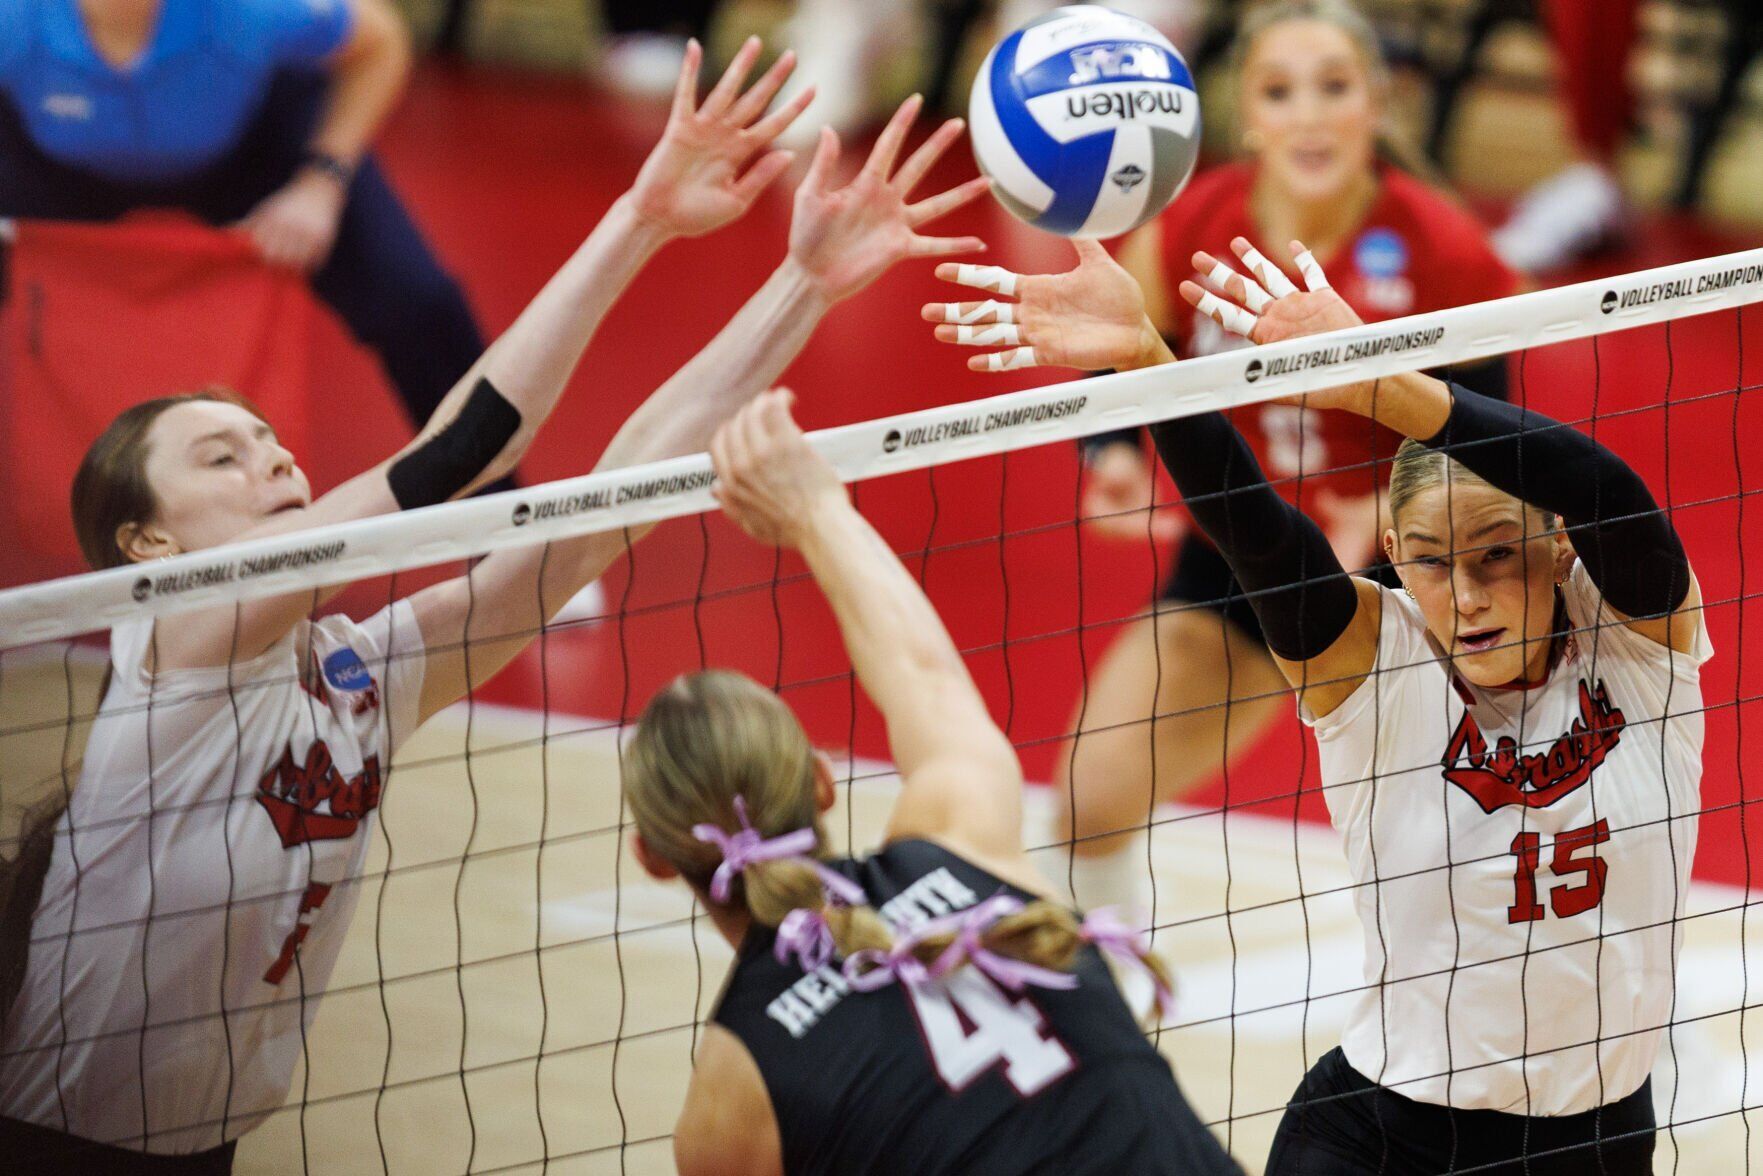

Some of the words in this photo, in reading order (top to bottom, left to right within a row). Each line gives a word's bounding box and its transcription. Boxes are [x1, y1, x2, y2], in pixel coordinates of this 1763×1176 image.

[1067, 90, 1183, 119] molten
[1620, 277, 1693, 308] VOLLEYBALL
[1264, 348, 1341, 377] VOLLEYBALL
[1343, 326, 1445, 360] CHAMPIONSHIP
[904, 418, 981, 448] VOLLEYBALL
[984, 395, 1088, 432] CHAMPIONSHIP
[532, 487, 613, 520] VOLLEYBALL
[154, 561, 235, 596] VOLLEYBALL
[237, 539, 347, 580] CHAMPIONSHIP
[1507, 817, 1611, 925] 15
[900, 962, 1078, 1098] 4
